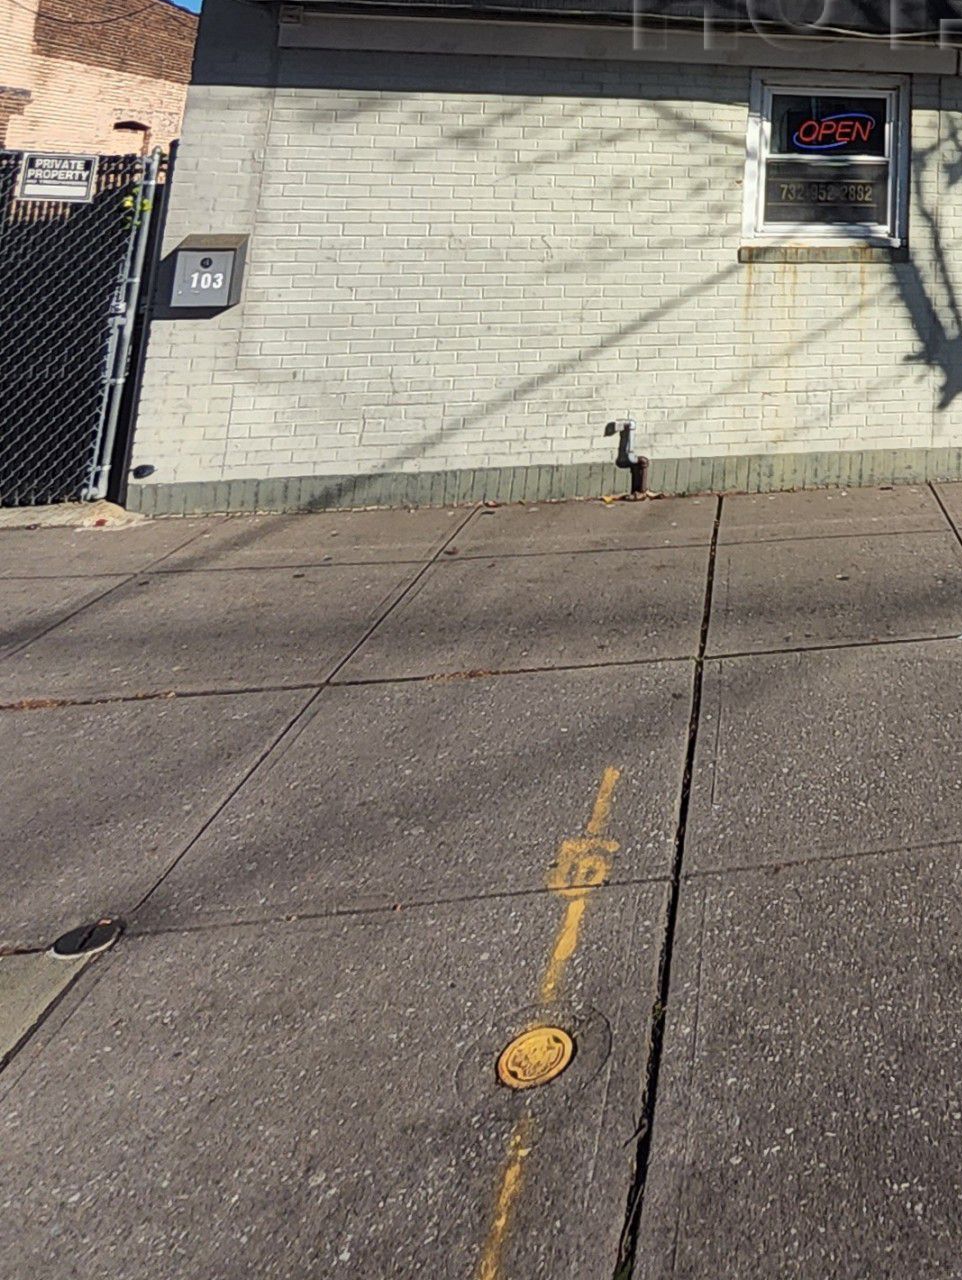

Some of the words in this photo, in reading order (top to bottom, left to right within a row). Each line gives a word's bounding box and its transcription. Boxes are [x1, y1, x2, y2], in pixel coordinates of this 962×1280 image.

[799, 121, 871, 142] OPEN
[34, 158, 86, 170] PRIVATE
[27, 169, 90, 181] PROPERTY
[190, 272, 223, 289] 103
